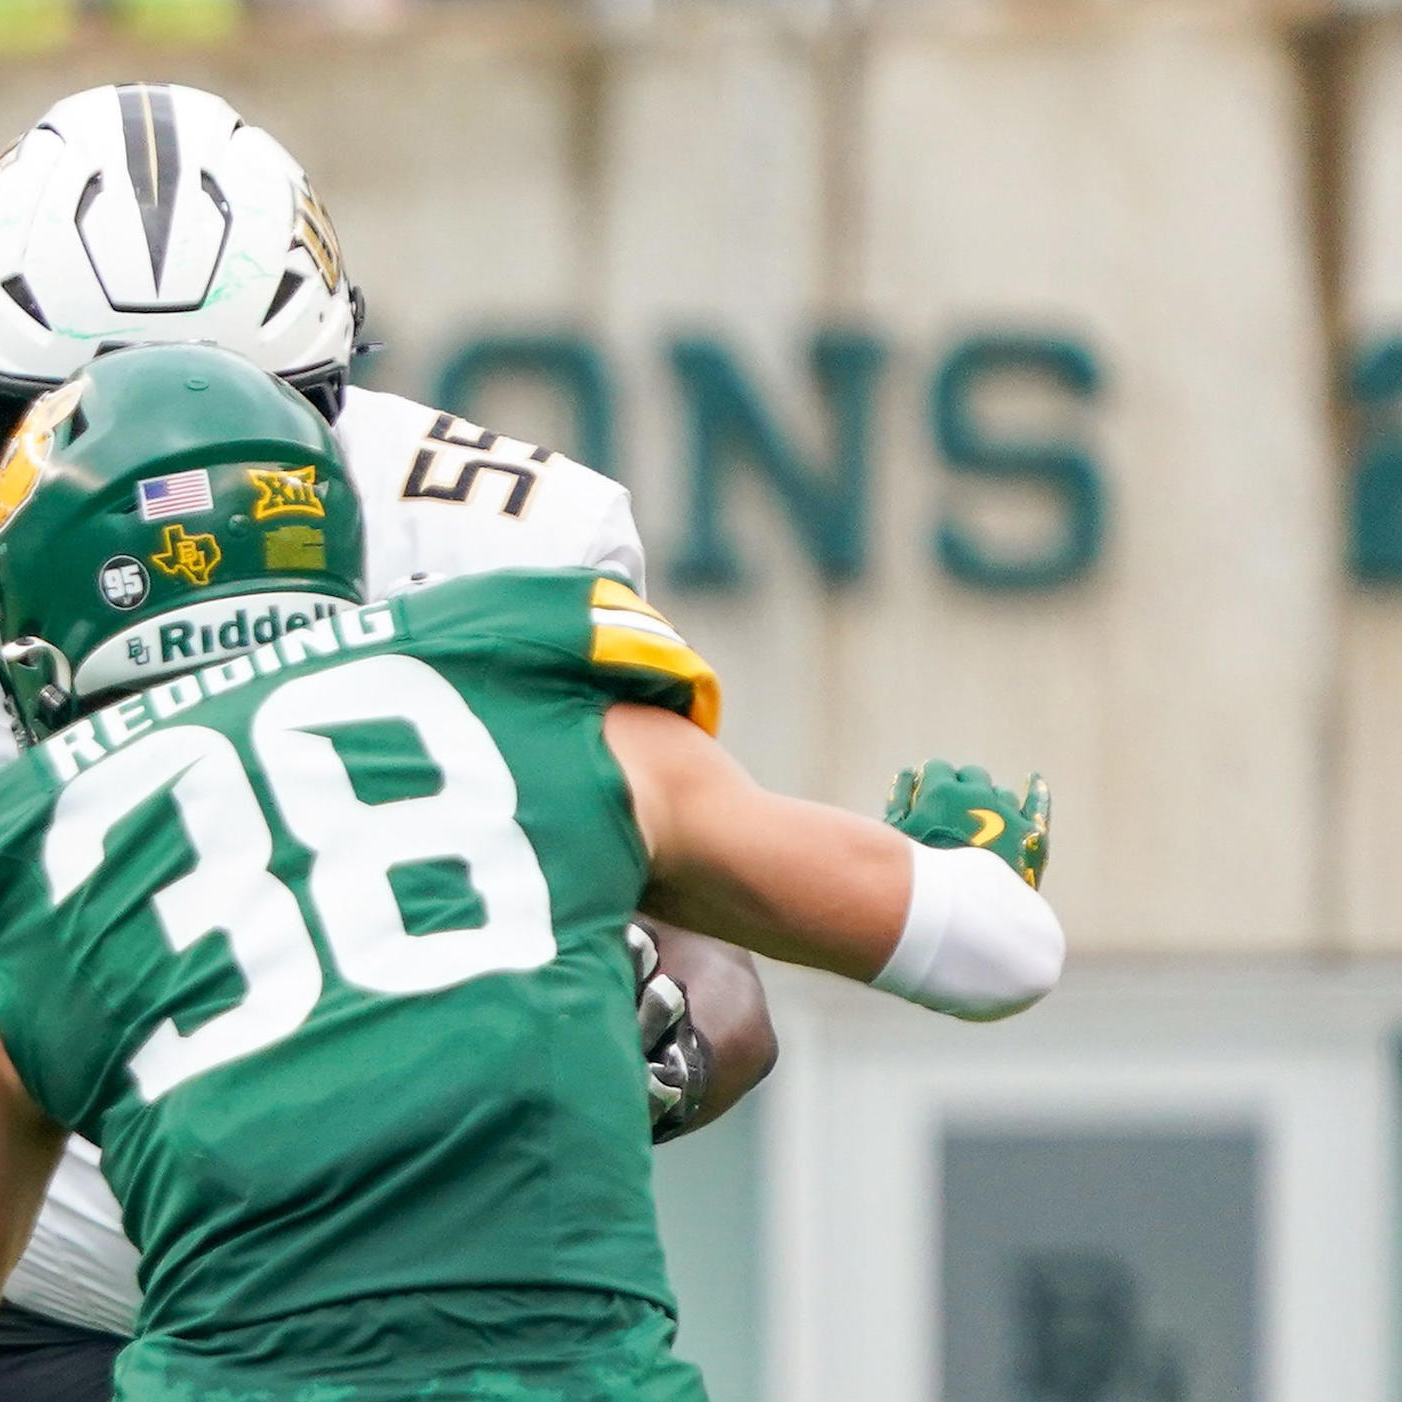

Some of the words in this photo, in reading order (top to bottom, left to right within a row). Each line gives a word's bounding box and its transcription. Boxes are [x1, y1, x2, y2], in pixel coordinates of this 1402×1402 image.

[103, 563, 144, 600] 95
[45, 600, 395, 782] REDDING
[44, 653, 558, 1105] 38
